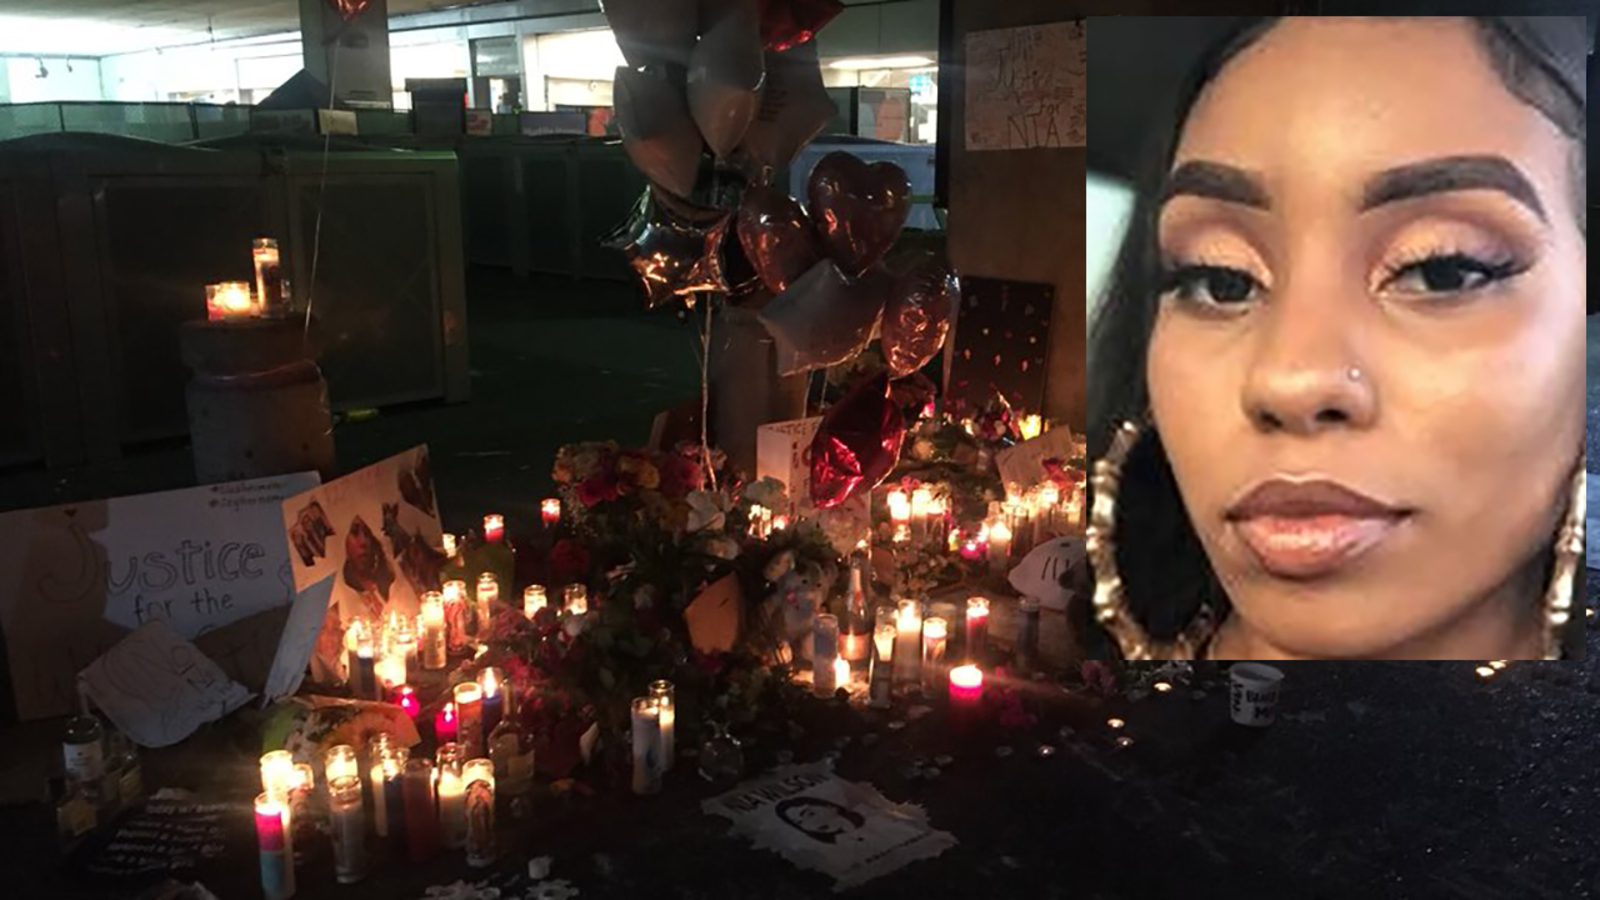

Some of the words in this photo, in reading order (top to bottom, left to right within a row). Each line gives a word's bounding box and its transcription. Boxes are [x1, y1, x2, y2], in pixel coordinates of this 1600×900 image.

[37, 525, 266, 603] Justice
[133, 591, 173, 626] for
[190, 587, 234, 615] the
